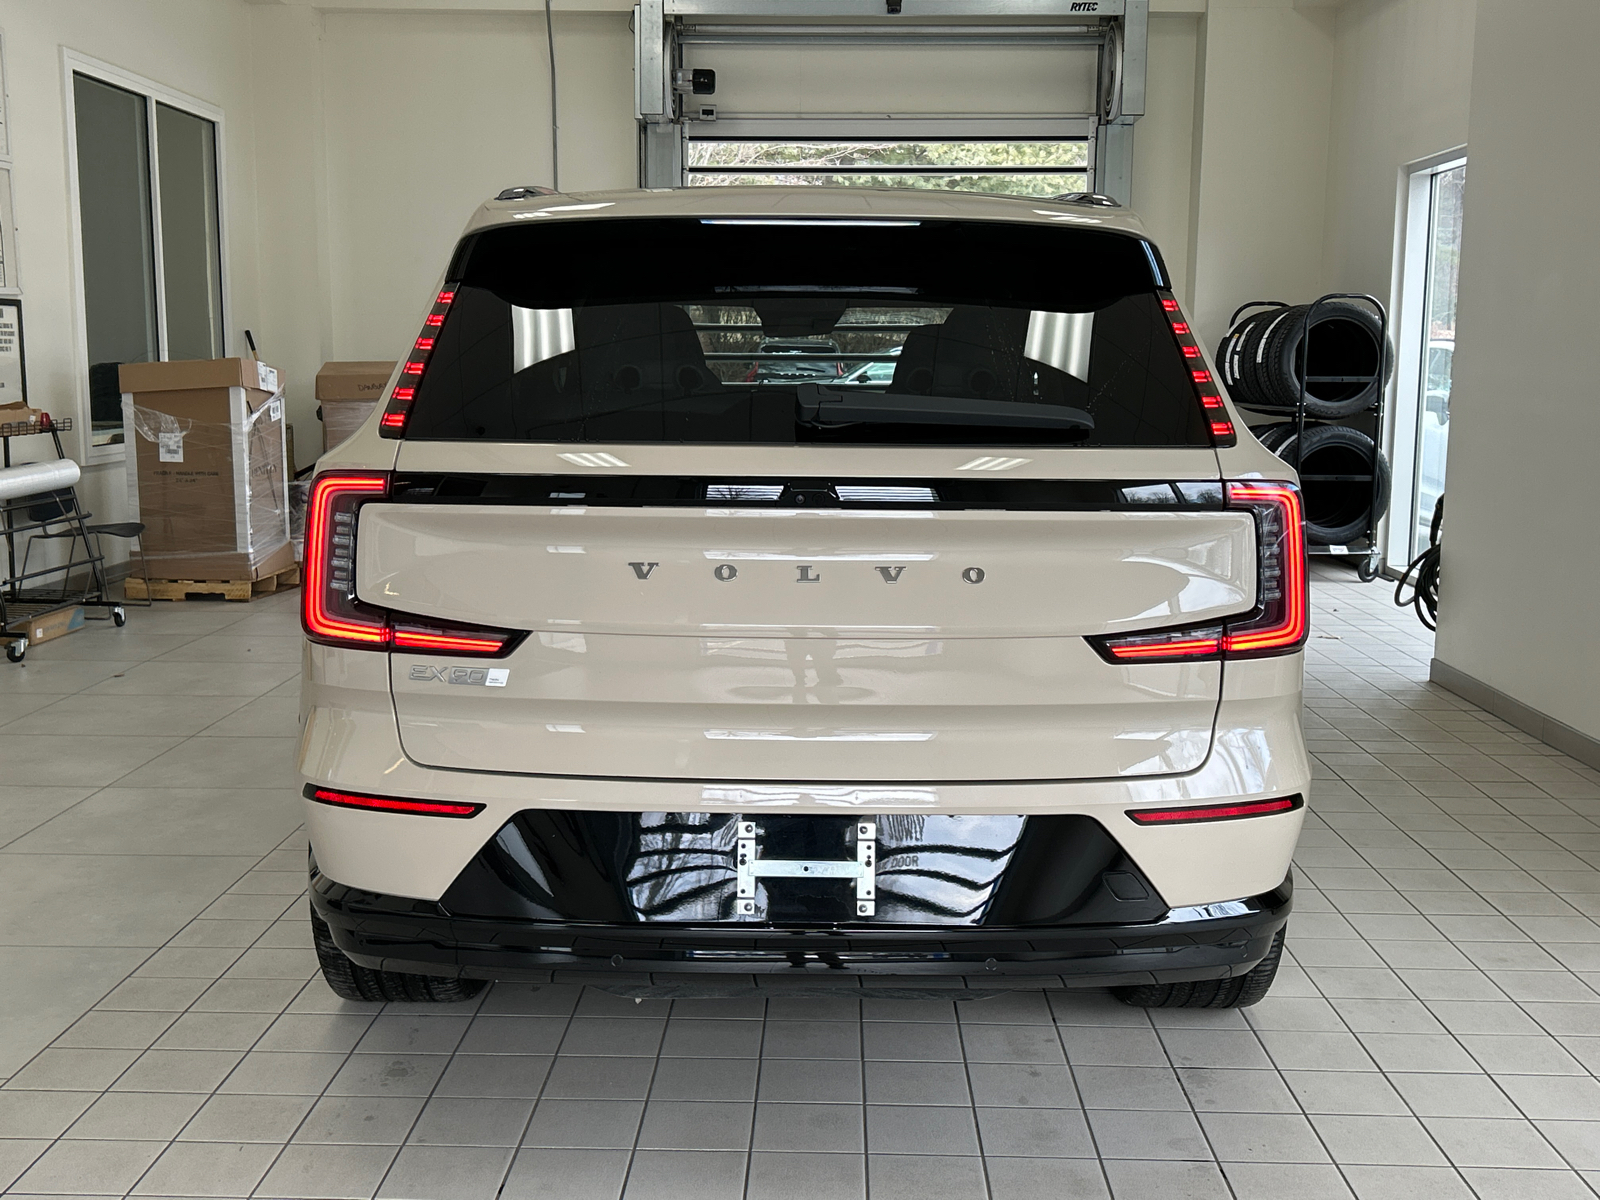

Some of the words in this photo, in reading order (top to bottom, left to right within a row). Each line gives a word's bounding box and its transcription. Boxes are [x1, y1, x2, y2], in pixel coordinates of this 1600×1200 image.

[1070, 2, 1099, 12] RYTEC
[628, 562, 986, 584] VOLVO
[409, 664, 487, 685] EX90
[891, 855, 919, 868] DOOR
